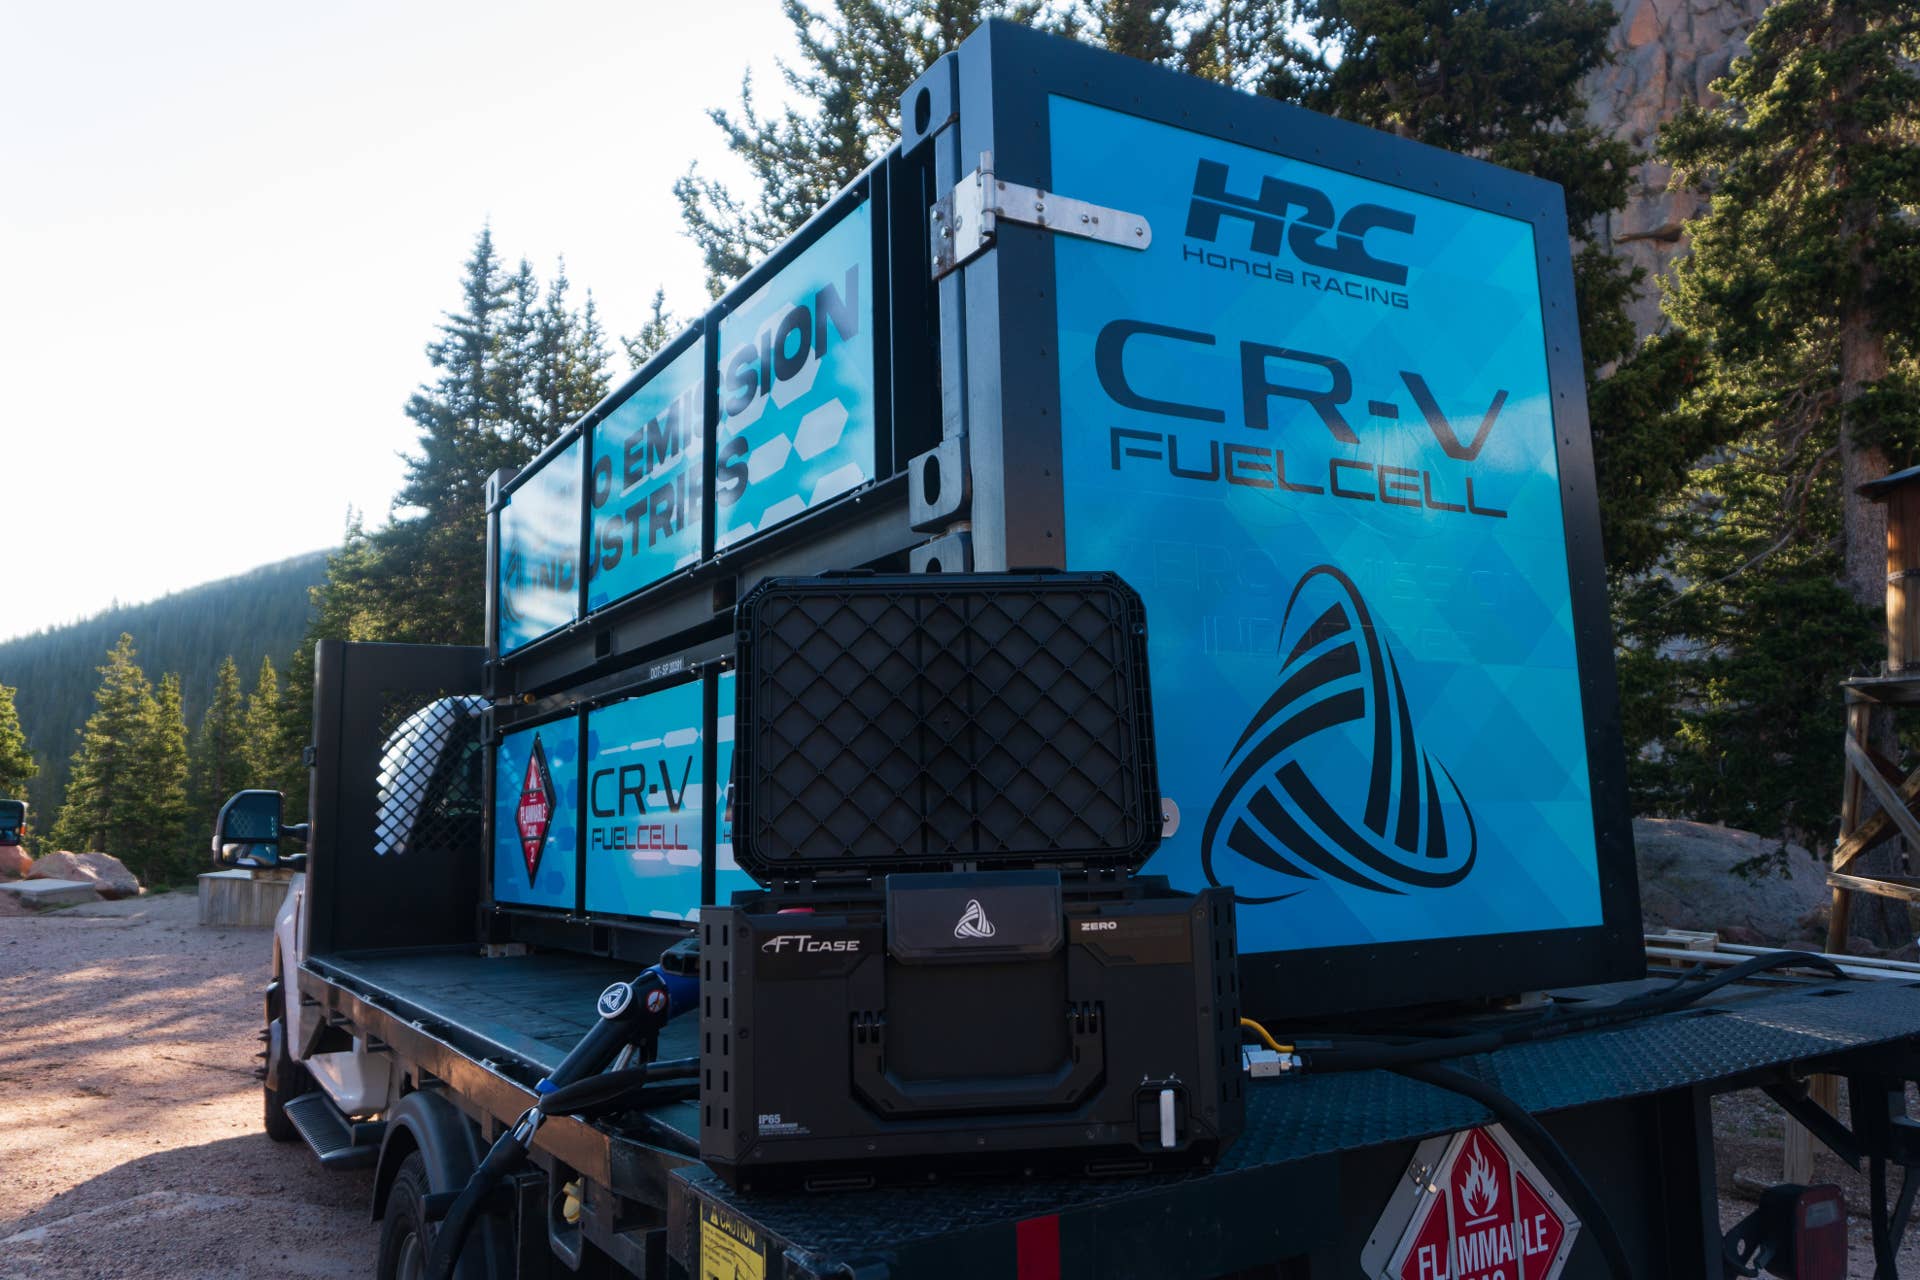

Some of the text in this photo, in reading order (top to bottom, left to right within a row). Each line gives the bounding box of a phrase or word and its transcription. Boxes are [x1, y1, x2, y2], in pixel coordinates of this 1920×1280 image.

[1185, 157, 1416, 287] HRC
[1183, 244, 1409, 310] Honda RACING
[1095, 319, 1508, 461] CR-V
[591, 755, 693, 818] CR-V
[1081, 921, 1117, 931] ZERO
[759, 1113, 781, 1125] IP65
[720, 1210, 756, 1248] CAUTION
